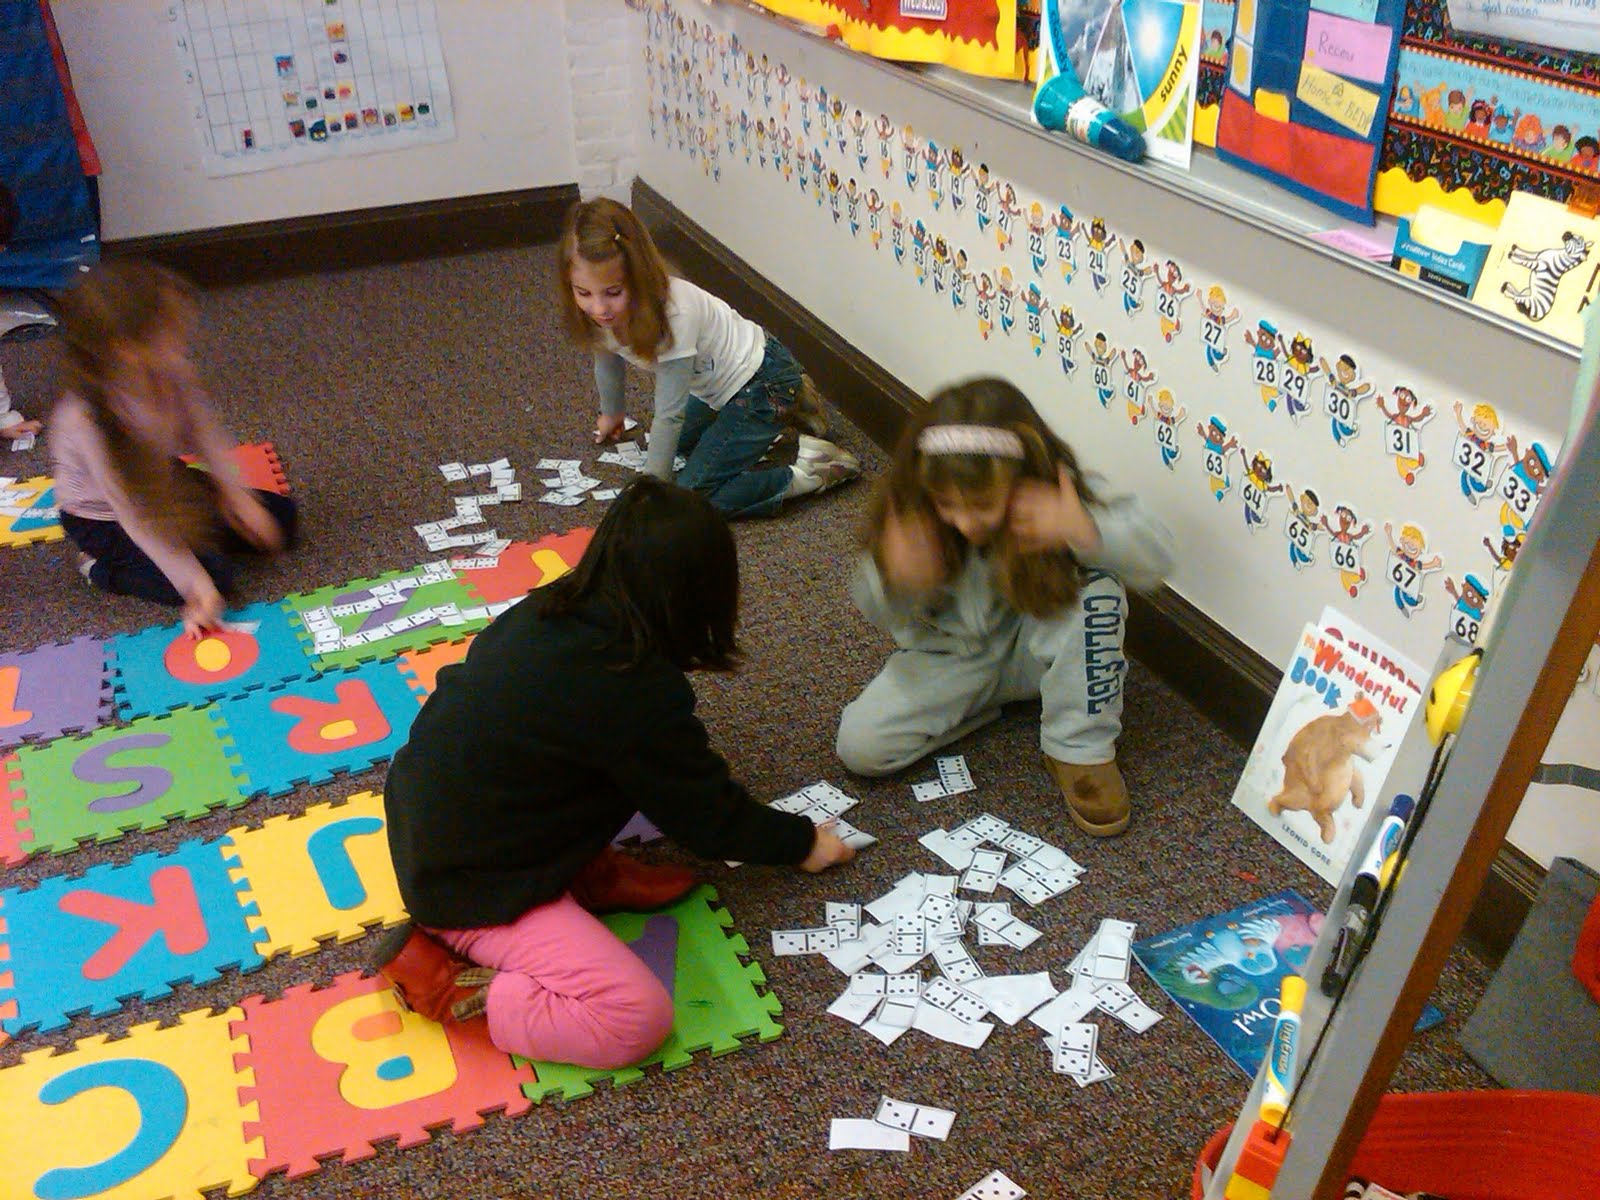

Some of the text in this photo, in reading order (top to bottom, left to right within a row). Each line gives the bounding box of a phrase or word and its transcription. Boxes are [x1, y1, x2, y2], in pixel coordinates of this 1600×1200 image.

[1160, 44, 1188, 103] sunny
[929, 172, 937, 190] 18
[951, 176, 959, 193] 19
[848, 204, 857, 220] 50
[976, 193, 988, 213] 20
[870, 214, 878, 230] 51
[998, 210, 1009, 231] 21
[892, 228, 900, 246] 52
[1030, 234, 1042, 255] 22
[914, 247, 924, 265] 53
[1058, 240, 1071, 260] 23
[1089, 251, 1103, 272] 24
[932, 259, 943, 280] 54
[951, 272, 962, 293] 55
[1122, 270, 1137, 295] 25
[978, 302, 989, 320] 56
[999, 295, 1010, 314] 57
[1158, 294, 1174, 318] 26
[1028, 315, 1040, 334] 58
[1204, 322, 1221, 345] 27
[1059, 336, 1071, 358] 59
[1094, 366, 1108, 386] 60
[1256, 360, 1275, 383] 28
[1127, 381, 1138, 402] 61
[1283, 369, 1305, 398] 29
[1328, 392, 1350, 420] 30
[1158, 425, 1172, 446] 62
[1392, 428, 1410, 454] 31
[1206, 453, 1222, 475] 63
[1458, 442, 1486, 477] 32
[1244, 484, 1262, 510] 64
[1503, 476, 1530, 512] 33
[1289, 521, 1309, 547] 65
[1335, 546, 1356, 568] 66
[1392, 562, 1416, 588] 67
[1456, 616, 1478, 644] 68
[1083, 595, 1124, 715] COLLEGE
[1290, 656, 1342, 709] Book
[1313, 638, 1408, 714] Wonderful
[271, 680, 392, 755] R
[72, 734, 174, 813] S
[1281, 824, 1309, 848] LEONID
[307, 817, 385, 911] J
[59, 865, 209, 981] K
[1231, 997, 1282, 1036] Owl
[1278, 1022, 1296, 1045] Dry
[311, 987, 459, 1110] B
[33, 1057, 189, 1200] C
